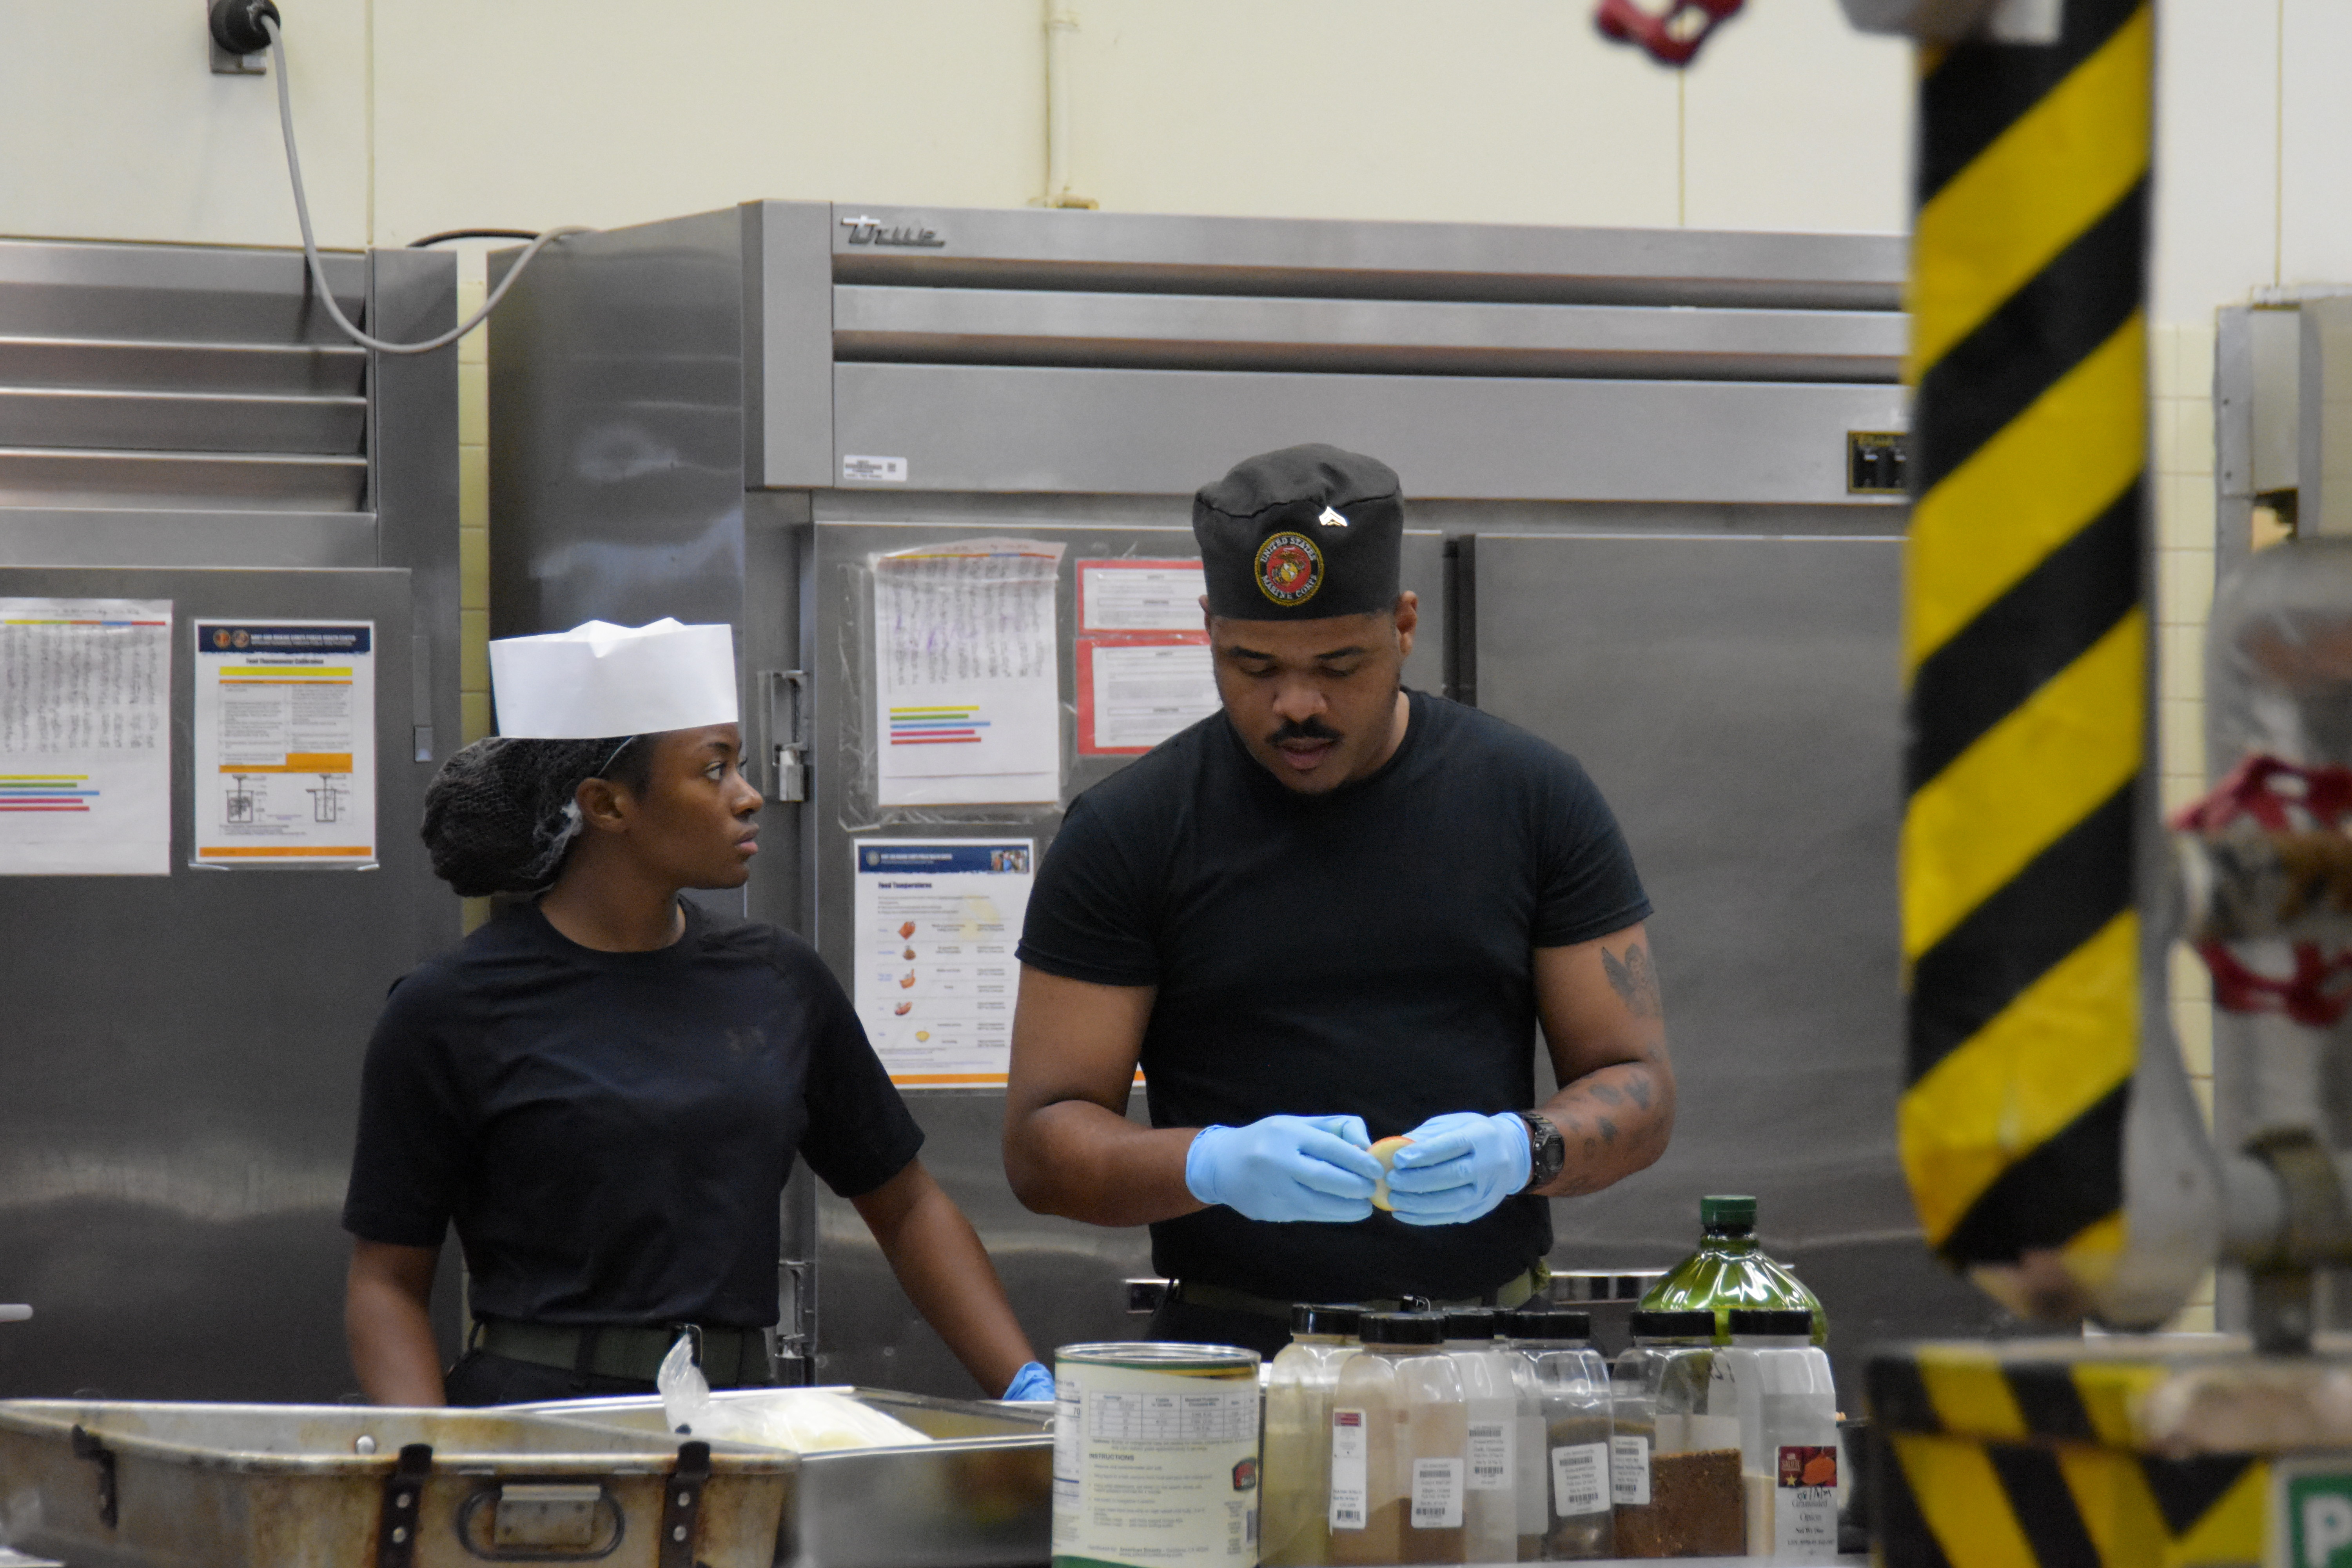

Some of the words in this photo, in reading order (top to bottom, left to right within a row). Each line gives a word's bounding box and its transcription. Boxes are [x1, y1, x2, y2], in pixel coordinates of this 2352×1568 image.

[1260, 537, 1288, 562] UNITED
[1290, 537, 1317, 561] STATES
[1262, 575, 1292, 599] MARINE
[1089, 1453, 1134, 1461] INSTRUCTIONS
